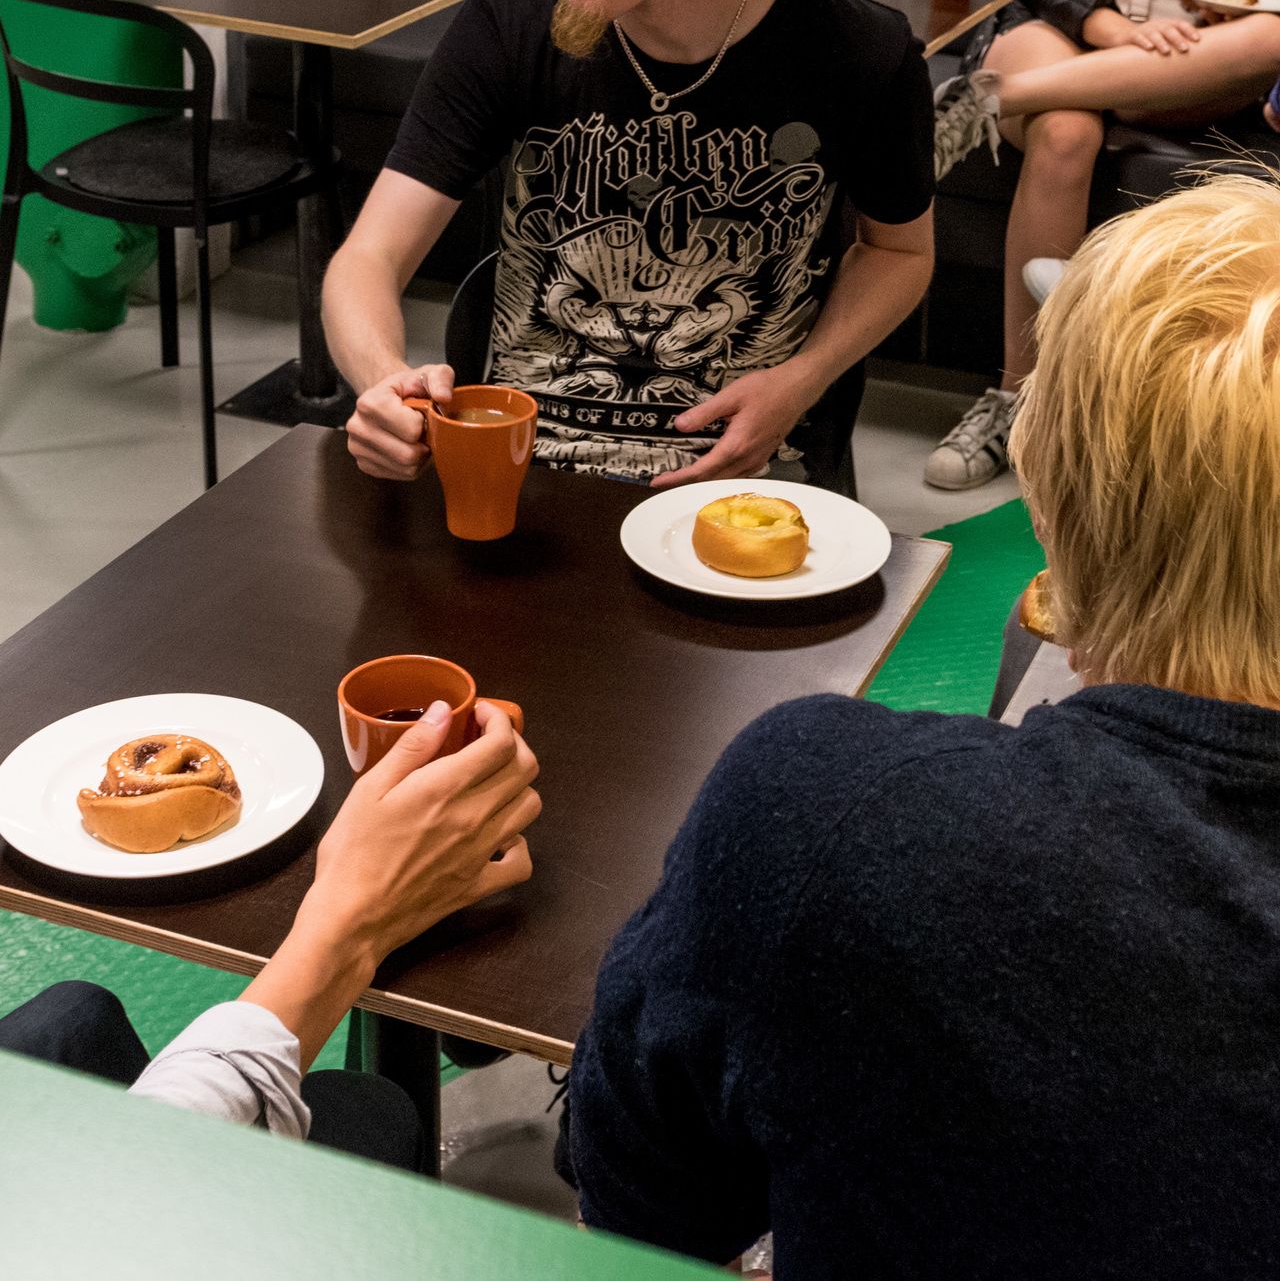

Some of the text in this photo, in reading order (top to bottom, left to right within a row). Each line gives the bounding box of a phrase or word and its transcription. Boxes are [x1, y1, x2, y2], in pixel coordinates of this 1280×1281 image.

[513, 111, 824, 221] Mötley
[575, 407, 606, 425] OF
[611, 411, 658, 428] LOS
